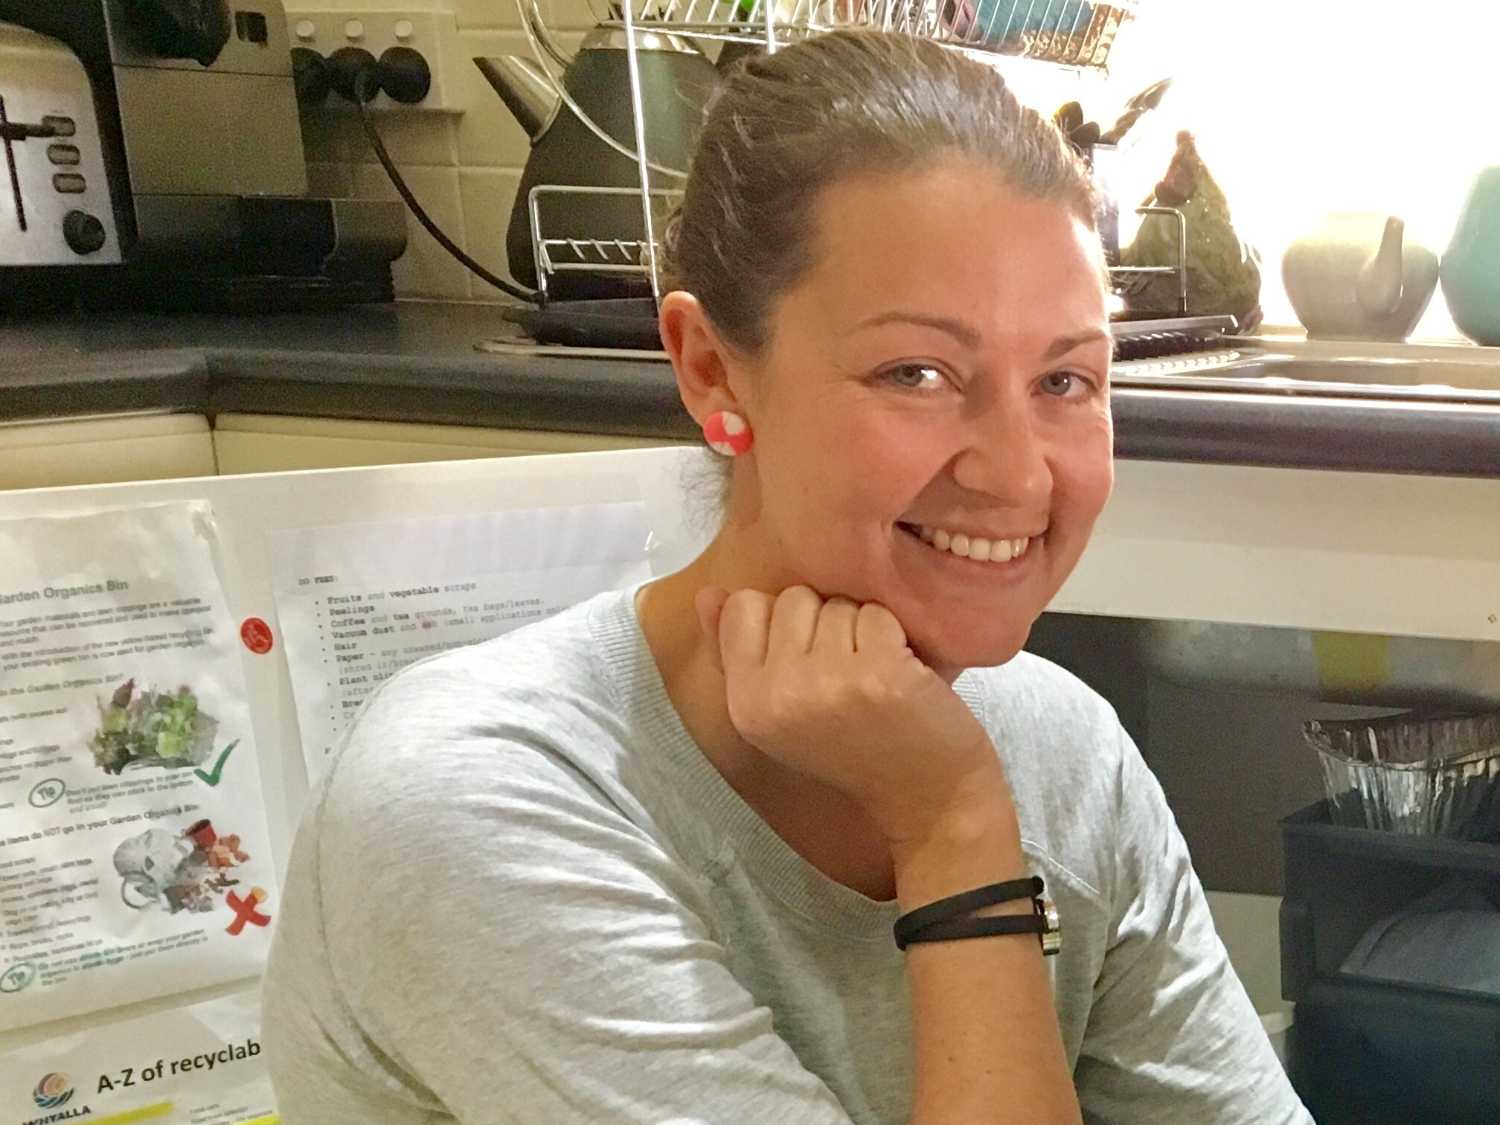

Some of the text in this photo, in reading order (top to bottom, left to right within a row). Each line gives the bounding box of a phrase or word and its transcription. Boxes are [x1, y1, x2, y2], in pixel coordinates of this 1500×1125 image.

[44, 586, 103, 600] Organics
[107, 579, 128, 592] Bin
[97, 1039, 261, 1094] A-Z of recyclab
